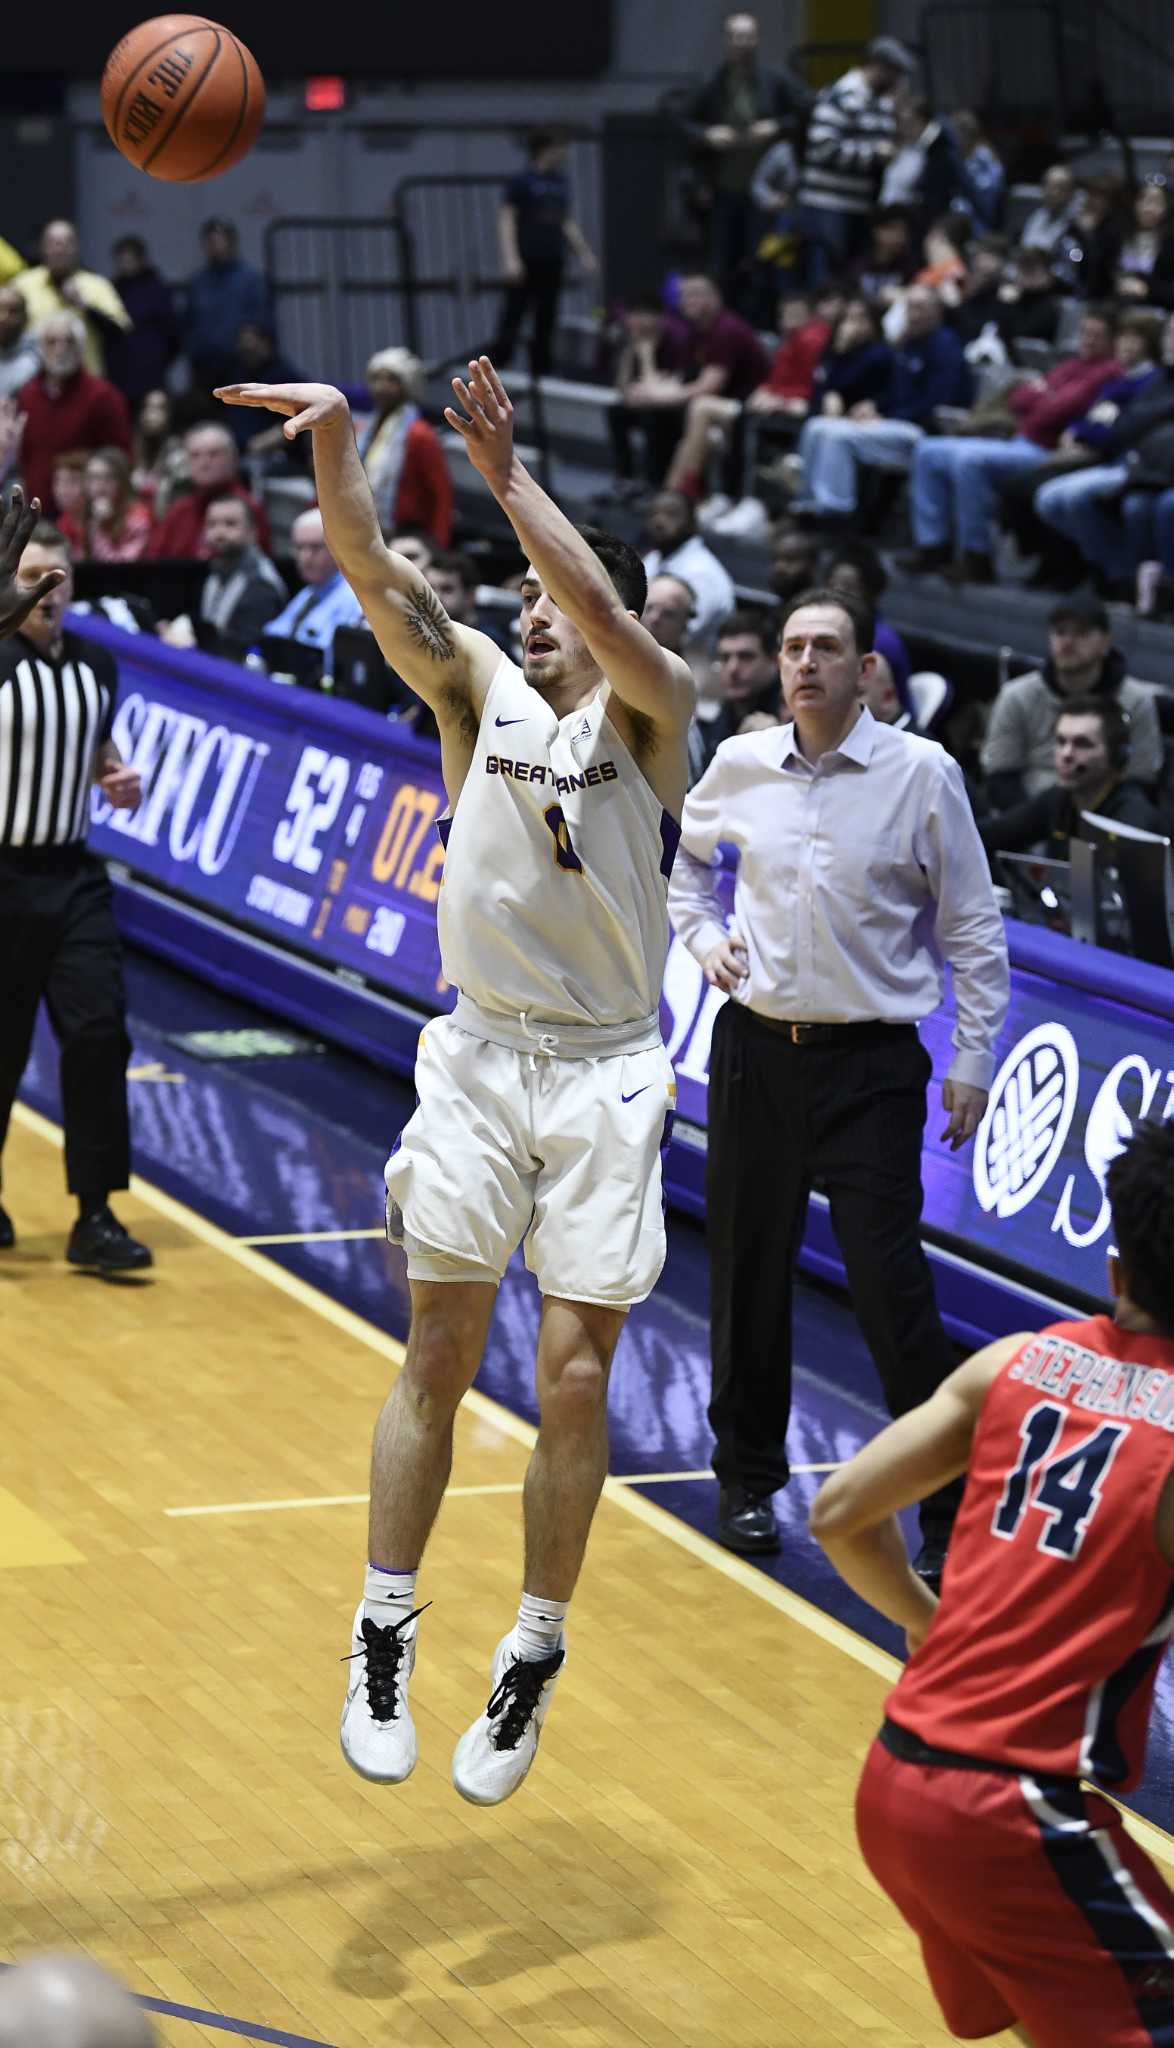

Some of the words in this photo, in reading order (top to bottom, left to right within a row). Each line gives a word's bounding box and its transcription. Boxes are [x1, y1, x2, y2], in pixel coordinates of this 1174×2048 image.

[147, 49, 194, 99] THE
[89, 691, 271, 877] SEFCU
[272, 746, 350, 875] 52
[1008, 1333, 1174, 1433] STEPHENSO
[990, 1399, 1132, 1562] 14
